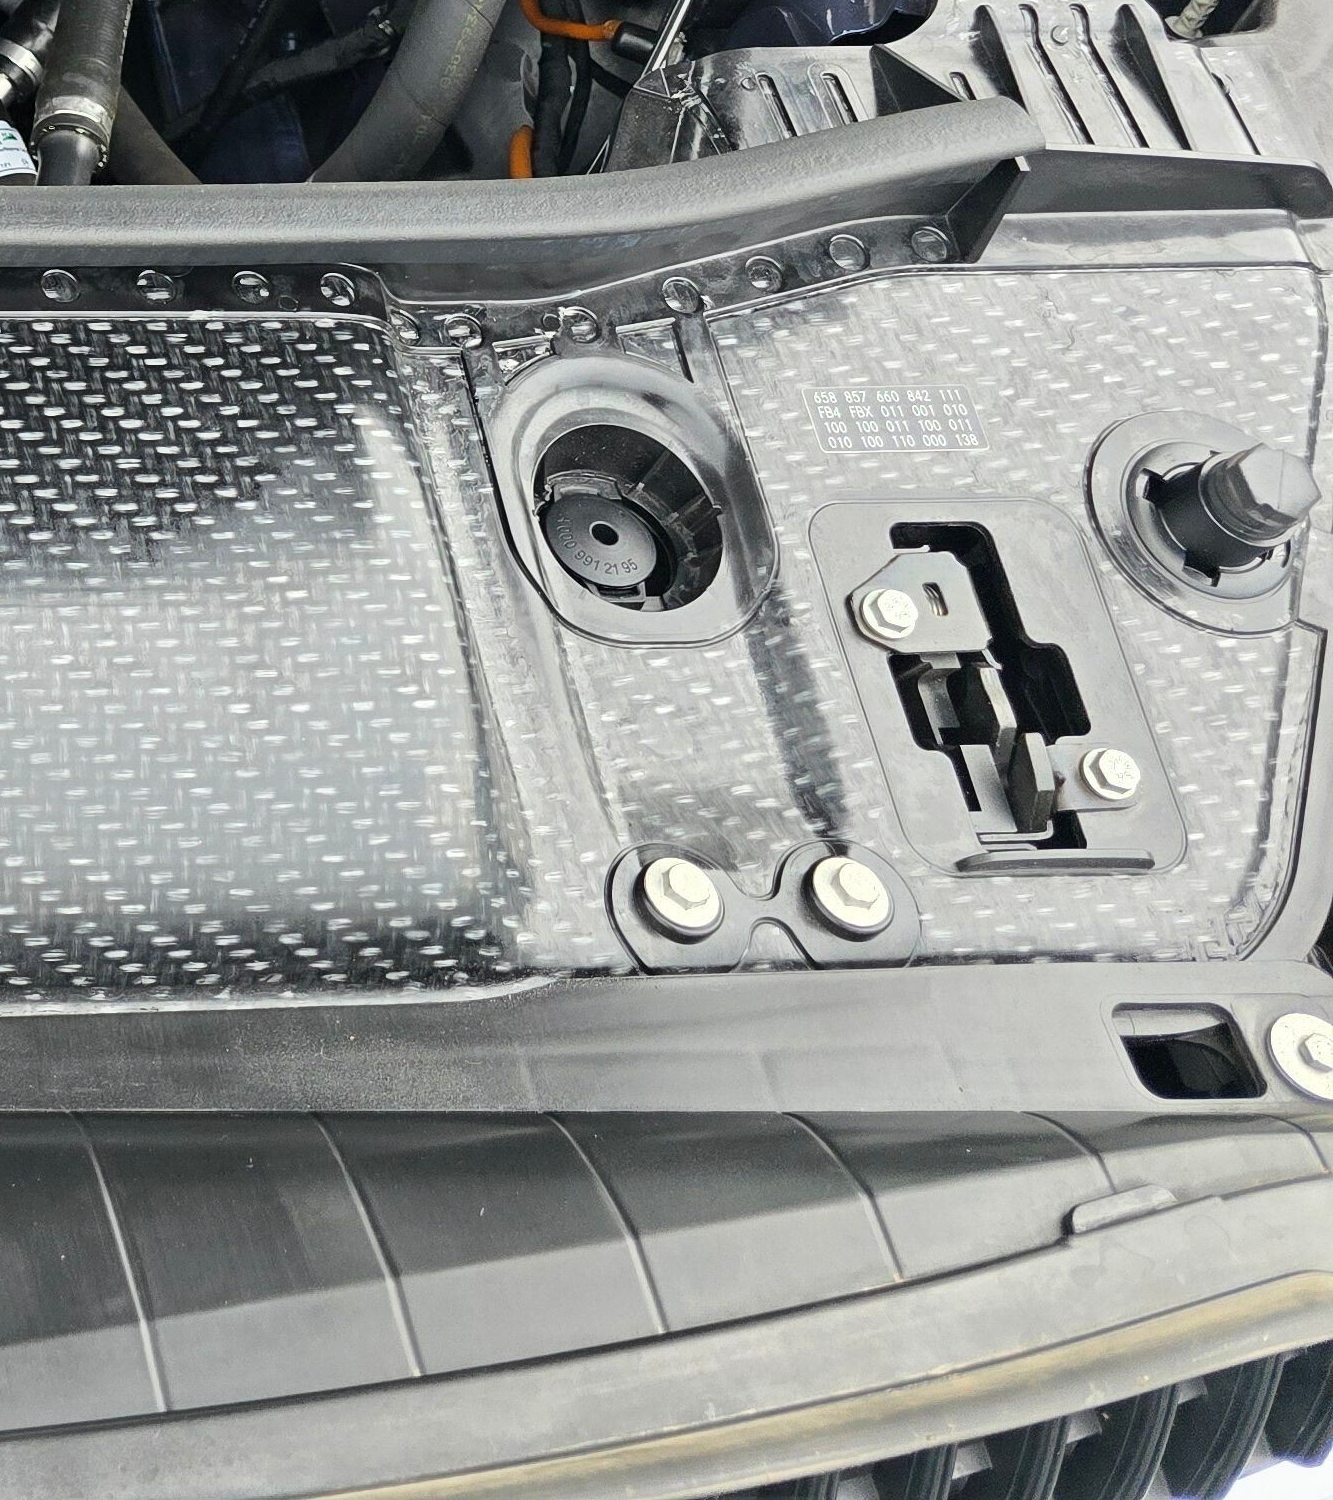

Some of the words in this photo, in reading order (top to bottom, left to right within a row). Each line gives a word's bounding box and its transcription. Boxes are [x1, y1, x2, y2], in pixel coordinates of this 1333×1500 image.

[814, 392, 837, 403] 658
[844, 391, 866, 403] 857
[877, 390, 899, 403] 660
[907, 390, 931, 402] 842
[939, 389, 961, 401] 111
[818, 406, 841, 419] FB4
[849, 406, 874, 418] FBX
[880, 405, 904, 418] 011
[912, 405, 935, 417] 001
[943, 404, 968, 416] 010
[824, 421, 847, 434] 100
[856, 421, 878, 433] 100
[886, 420, 910, 432] 011
[918, 420, 941, 431] 100
[949, 419, 973, 431] 011
[828, 437, 853, 449] 010
[861, 436, 884, 448] 100
[892, 435, 915, 447] 110
[923, 435, 947, 446] 000
[955, 434, 979, 446] 138
[574, 550, 601, 571] 991
[604, 563, 619, 575] 21
[621, 558, 638, 574] 95
